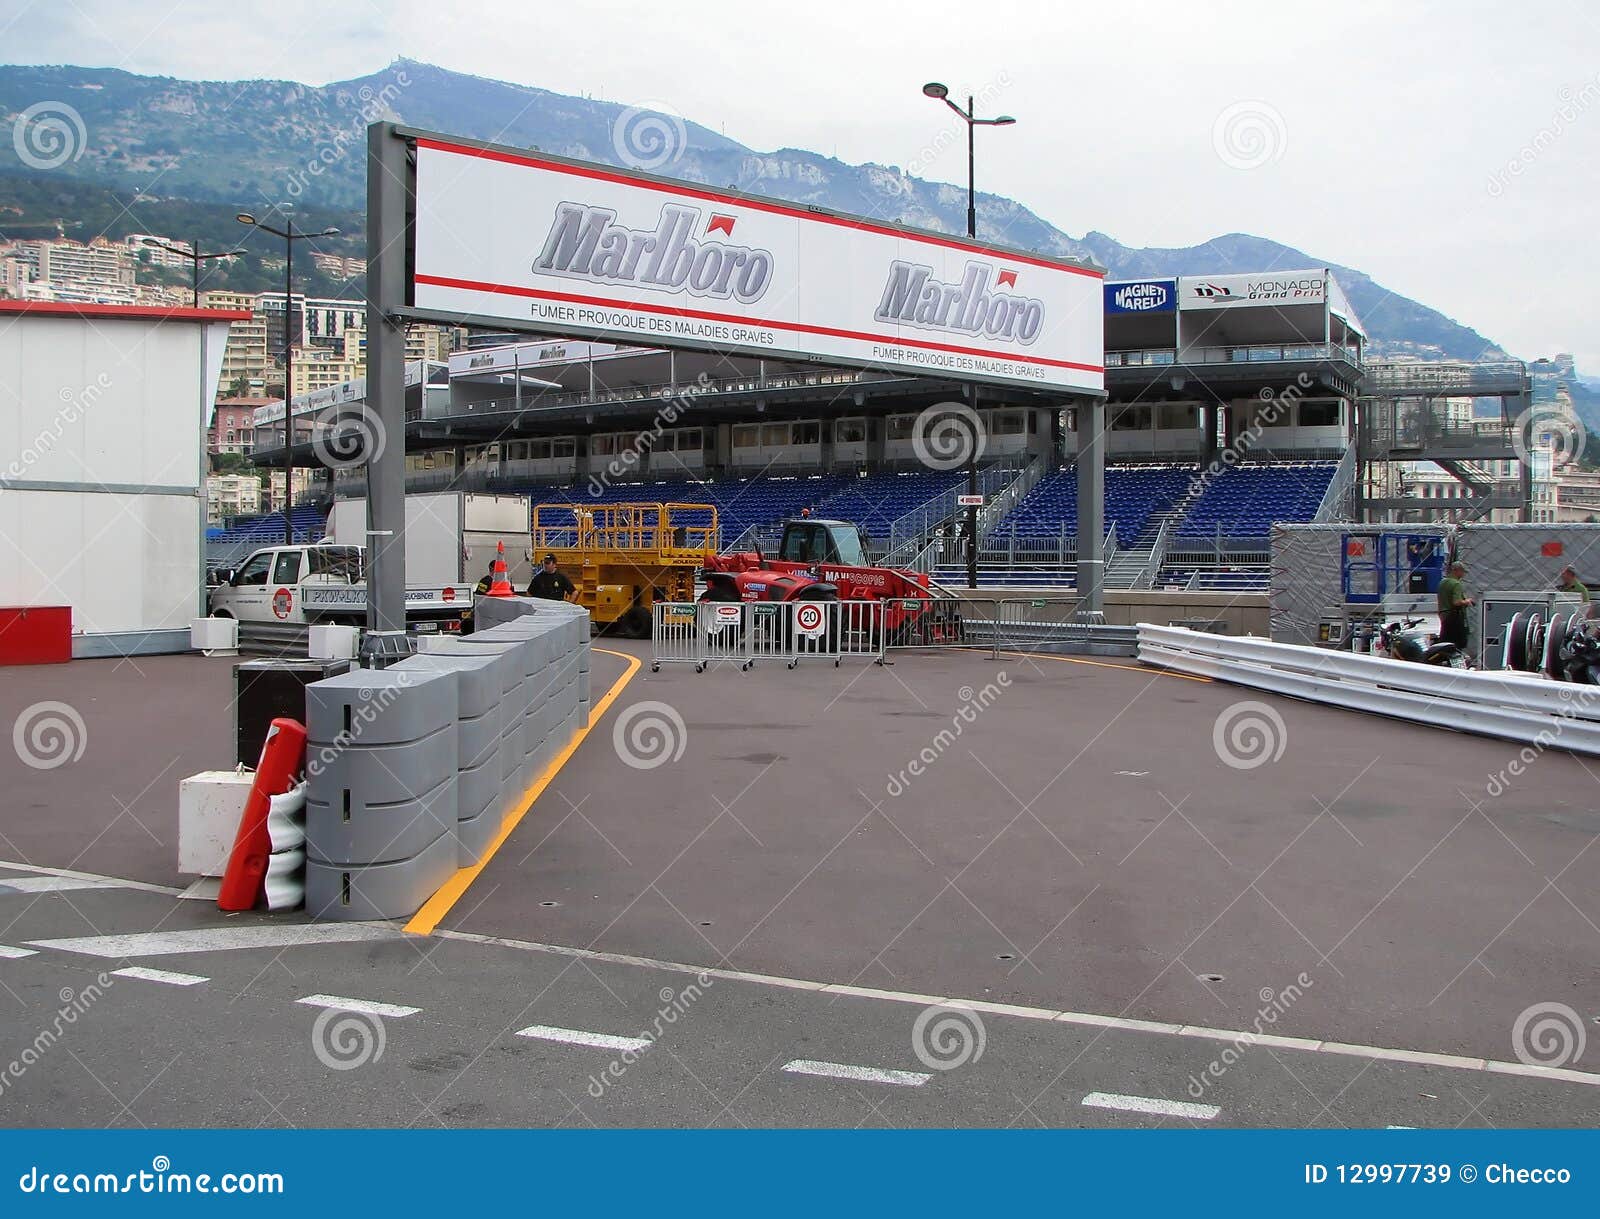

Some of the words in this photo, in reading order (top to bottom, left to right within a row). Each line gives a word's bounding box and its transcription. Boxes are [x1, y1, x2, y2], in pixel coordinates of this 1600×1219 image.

[536, 204, 772, 300] Marlboro
[877, 261, 1043, 342] Marlboro
[1248, 280, 1322, 292] MONACO
[1249, 291, 1288, 299] Grand
[1294, 289, 1321, 298] Prix
[531, 303, 575, 321] FUMER
[578, 311, 645, 330] PROVOQUE
[649, 318, 672, 333] DES
[675, 322, 729, 341] MALADIES
[731, 328, 774, 345] GRAVES
[873, 347, 905, 361] FUMER
[907, 351, 955, 368] PROVOQUE
[956, 357, 973, 370] DES
[975, 360, 1014, 375] MALADIES
[1015, 366, 1045, 379] GRAVES
[803, 611, 817, 622] 20
